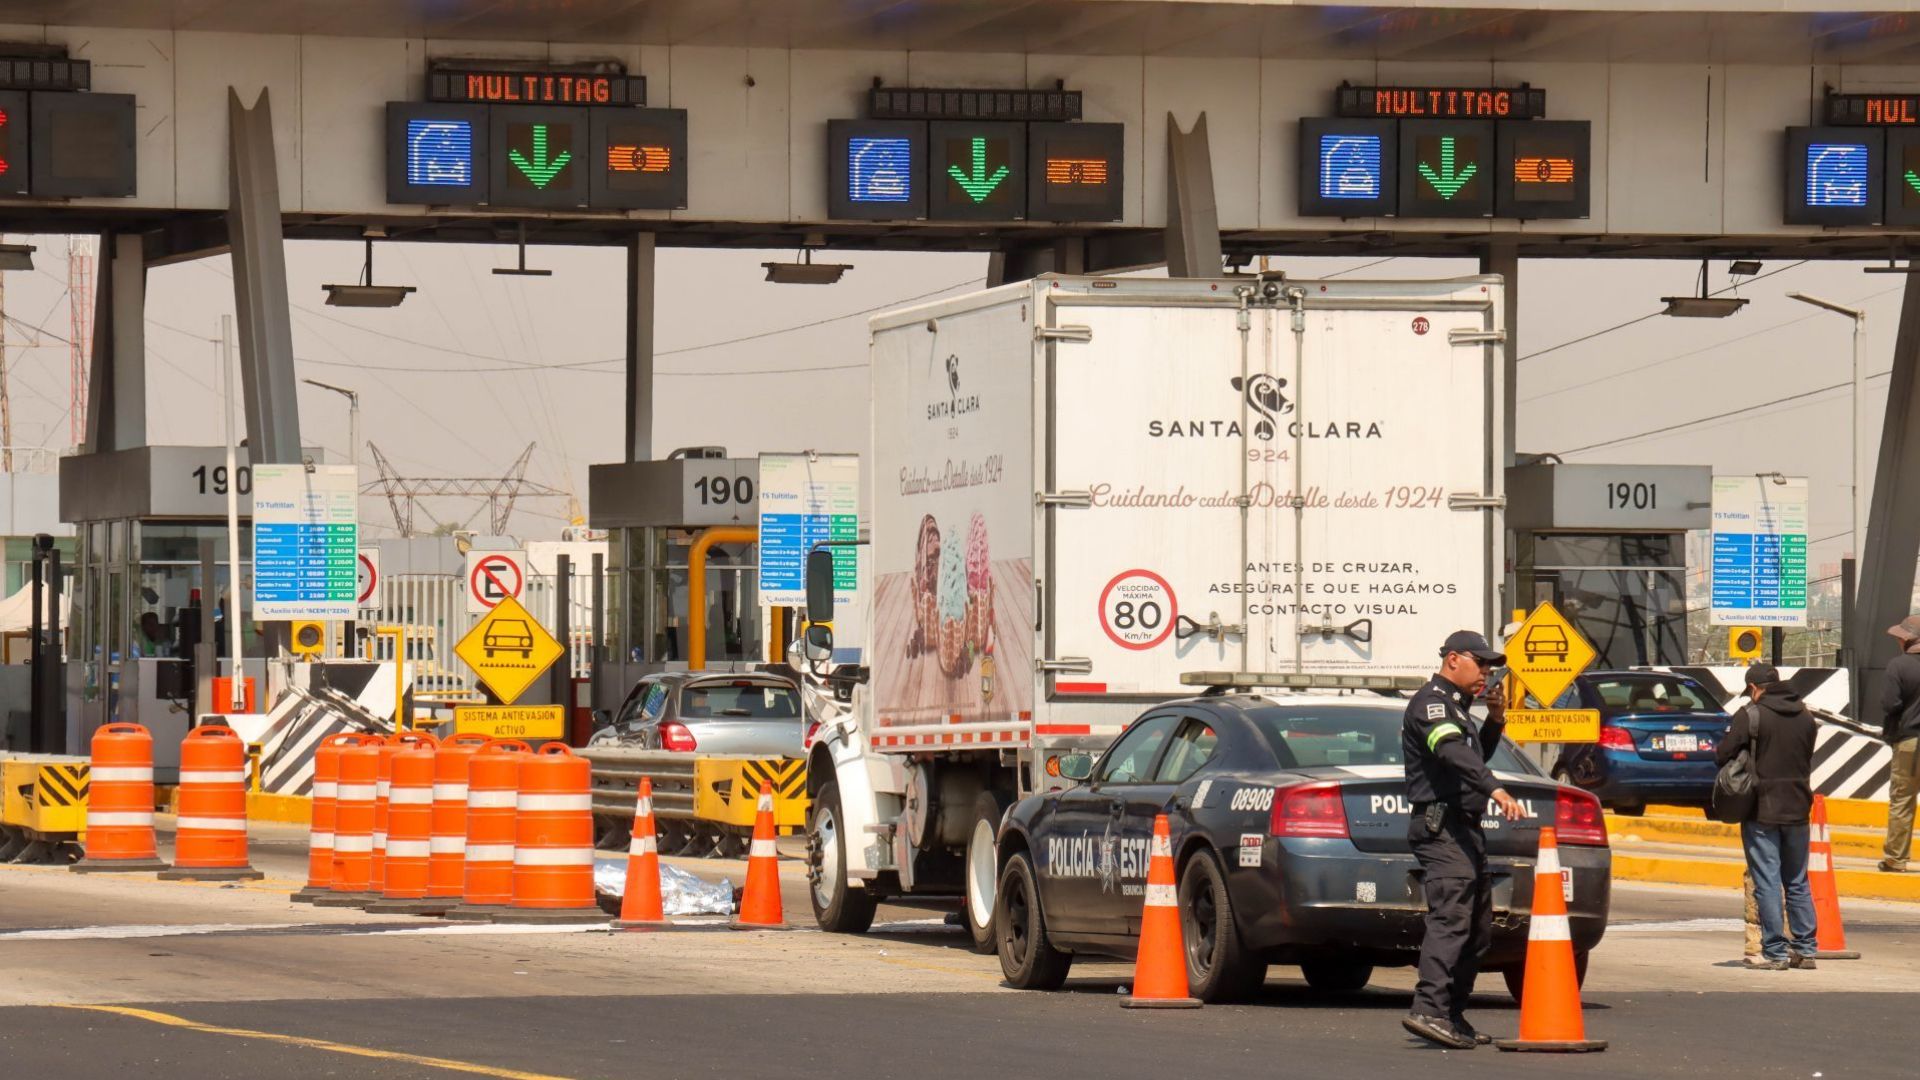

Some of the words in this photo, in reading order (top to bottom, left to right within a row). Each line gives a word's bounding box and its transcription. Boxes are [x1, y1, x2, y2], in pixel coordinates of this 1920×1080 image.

[467, 75, 609, 102] MULTITAG
[1376, 90, 1509, 115] MULTITAG
[1866, 99, 1920, 123] MUL
[1413, 321, 1429, 332] 278
[927, 401, 949, 420] SANTA
[957, 395, 980, 414] CLARA
[1148, 420, 1243, 438] SANTA
[1287, 421, 1382, 439] CLARA
[1247, 449, 1290, 462] 924
[192, 465, 253, 495] 190
[985, 454, 1003, 484] 1924
[694, 476, 753, 505] 190
[1089, 483, 1197, 508] Cuidando
[1249, 481, 1330, 509] Detlle
[1334, 492, 1379, 509] desde
[1385, 486, 1444, 509] 1924
[1607, 482, 1656, 510] 1901
[1312, 562, 1335, 573] DE
[1342, 562, 1419, 575] CRUZAR,
[1208, 580, 1315, 594] ASEGÚRAE
[1323, 583, 1360, 594] QUE
[1369, 580, 1457, 594] HAGÁMOS
[1114, 601, 1162, 630] 80
[1248, 604, 1346, 615] CONTACTO
[1354, 604, 1418, 615] VISUAL
[1124, 632, 1152, 640] Km/hr
[463, 711, 498, 721] SISTEMA
[501, 710, 555, 721] ANTIEVASION
[1505, 714, 1537, 724] SISTEMA
[1540, 714, 1591, 724] ANTIEVASION
[494, 725, 526, 735] ACTIVO
[1533, 728, 1562, 738] ACTIVO
[1230, 788, 1275, 811] 08908
[1049, 829, 1095, 877] POLICÍA
[1120, 838, 1153, 878] ESTA
